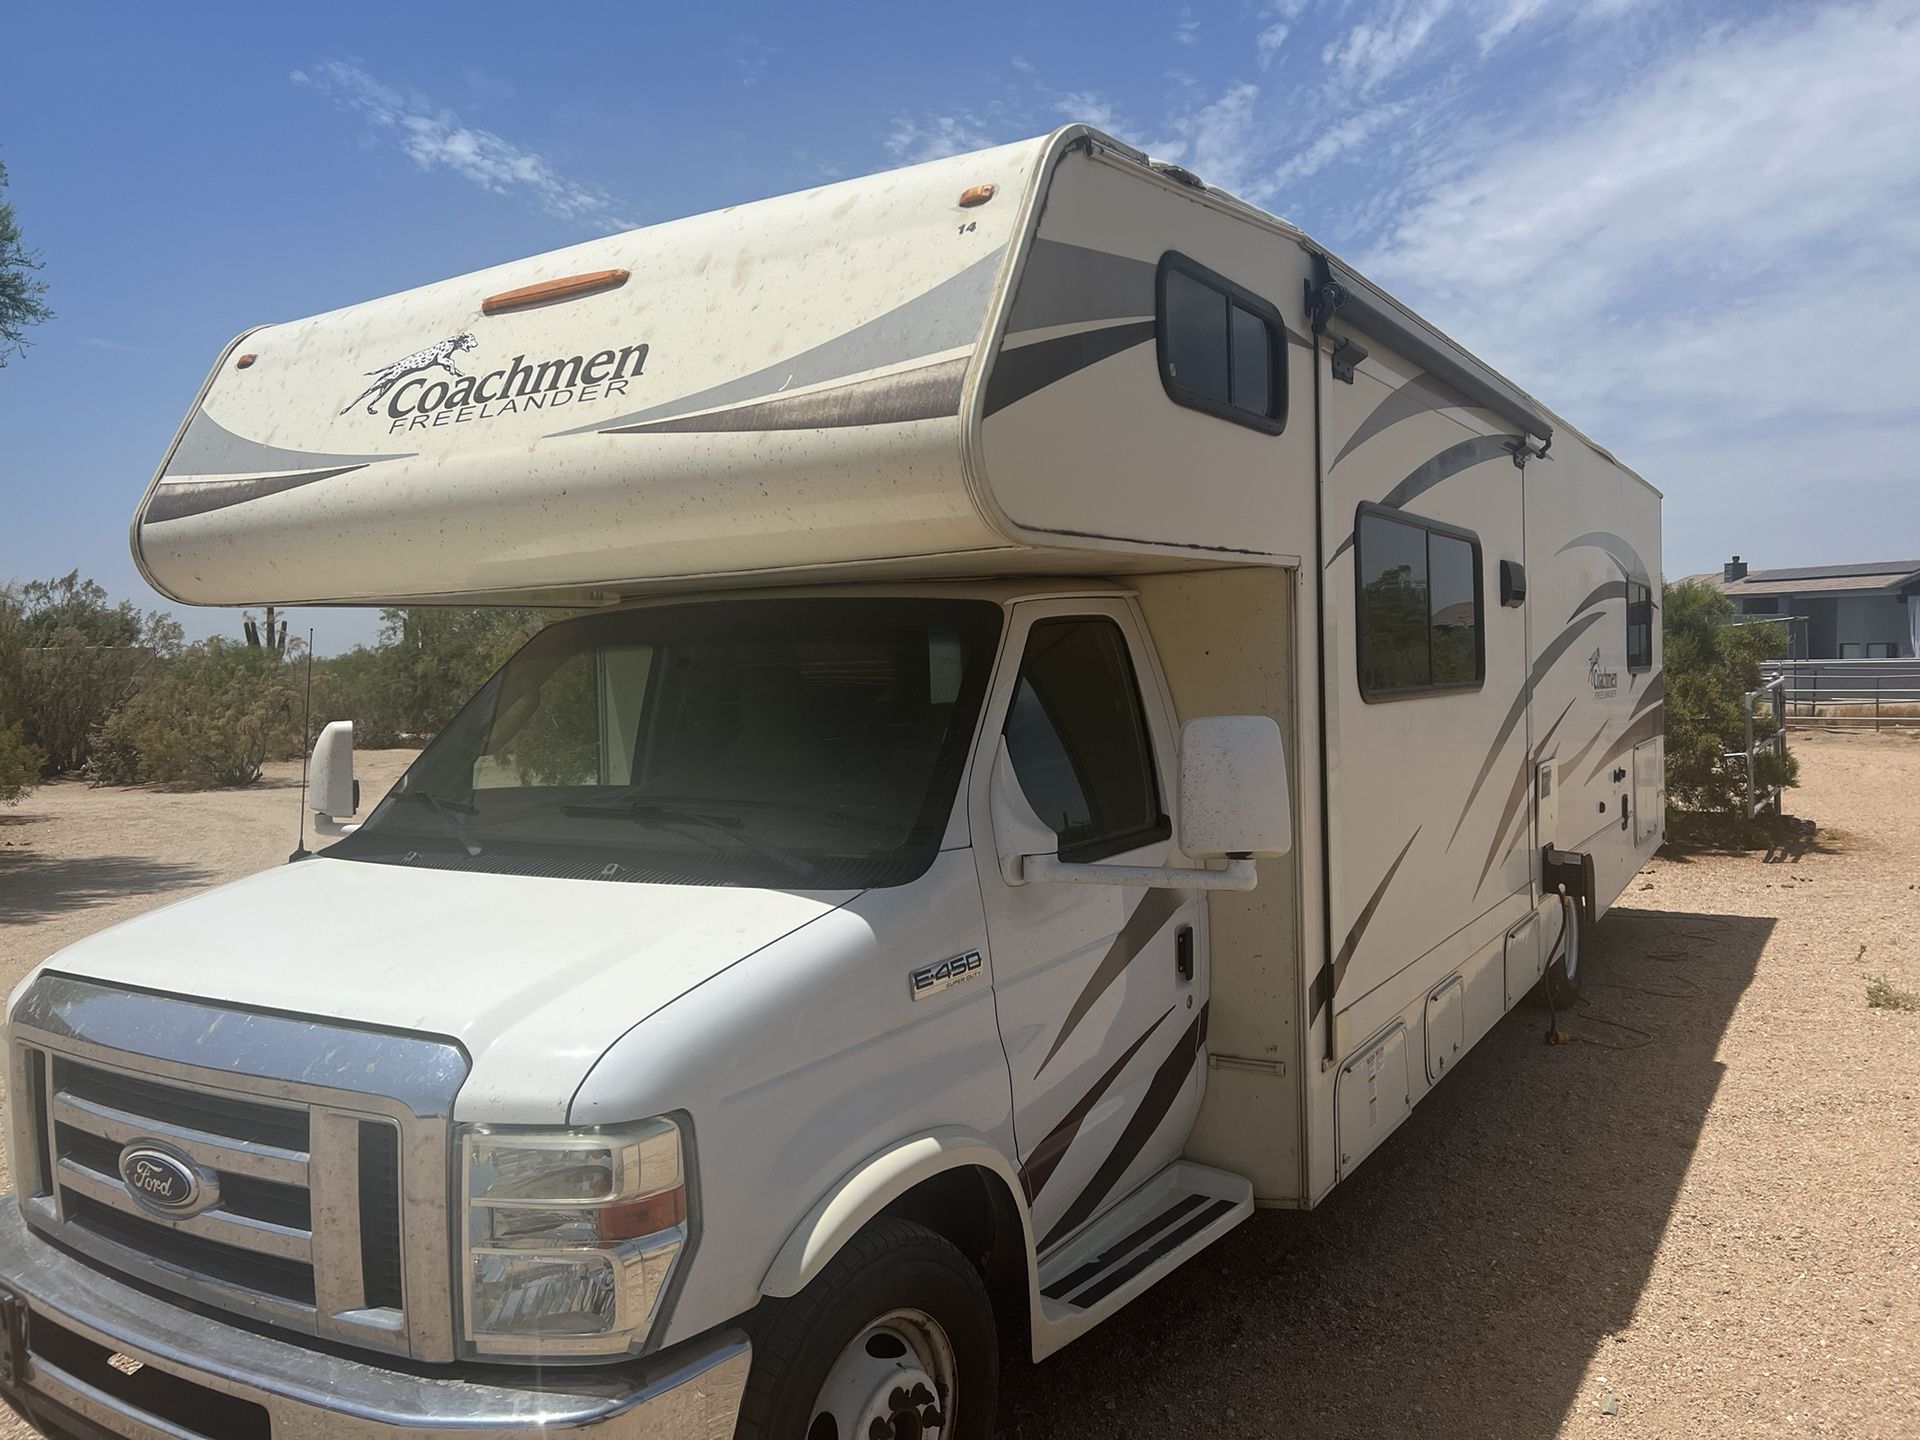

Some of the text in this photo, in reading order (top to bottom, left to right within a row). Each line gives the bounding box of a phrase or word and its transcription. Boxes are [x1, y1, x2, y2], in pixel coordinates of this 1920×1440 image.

[958, 221, 977, 235] 14
[388, 343, 649, 419] Coachmen
[388, 379, 629, 434] FREELANDER
[912, 951, 982, 990] E-450
[133, 1160, 173, 1197] Ford
